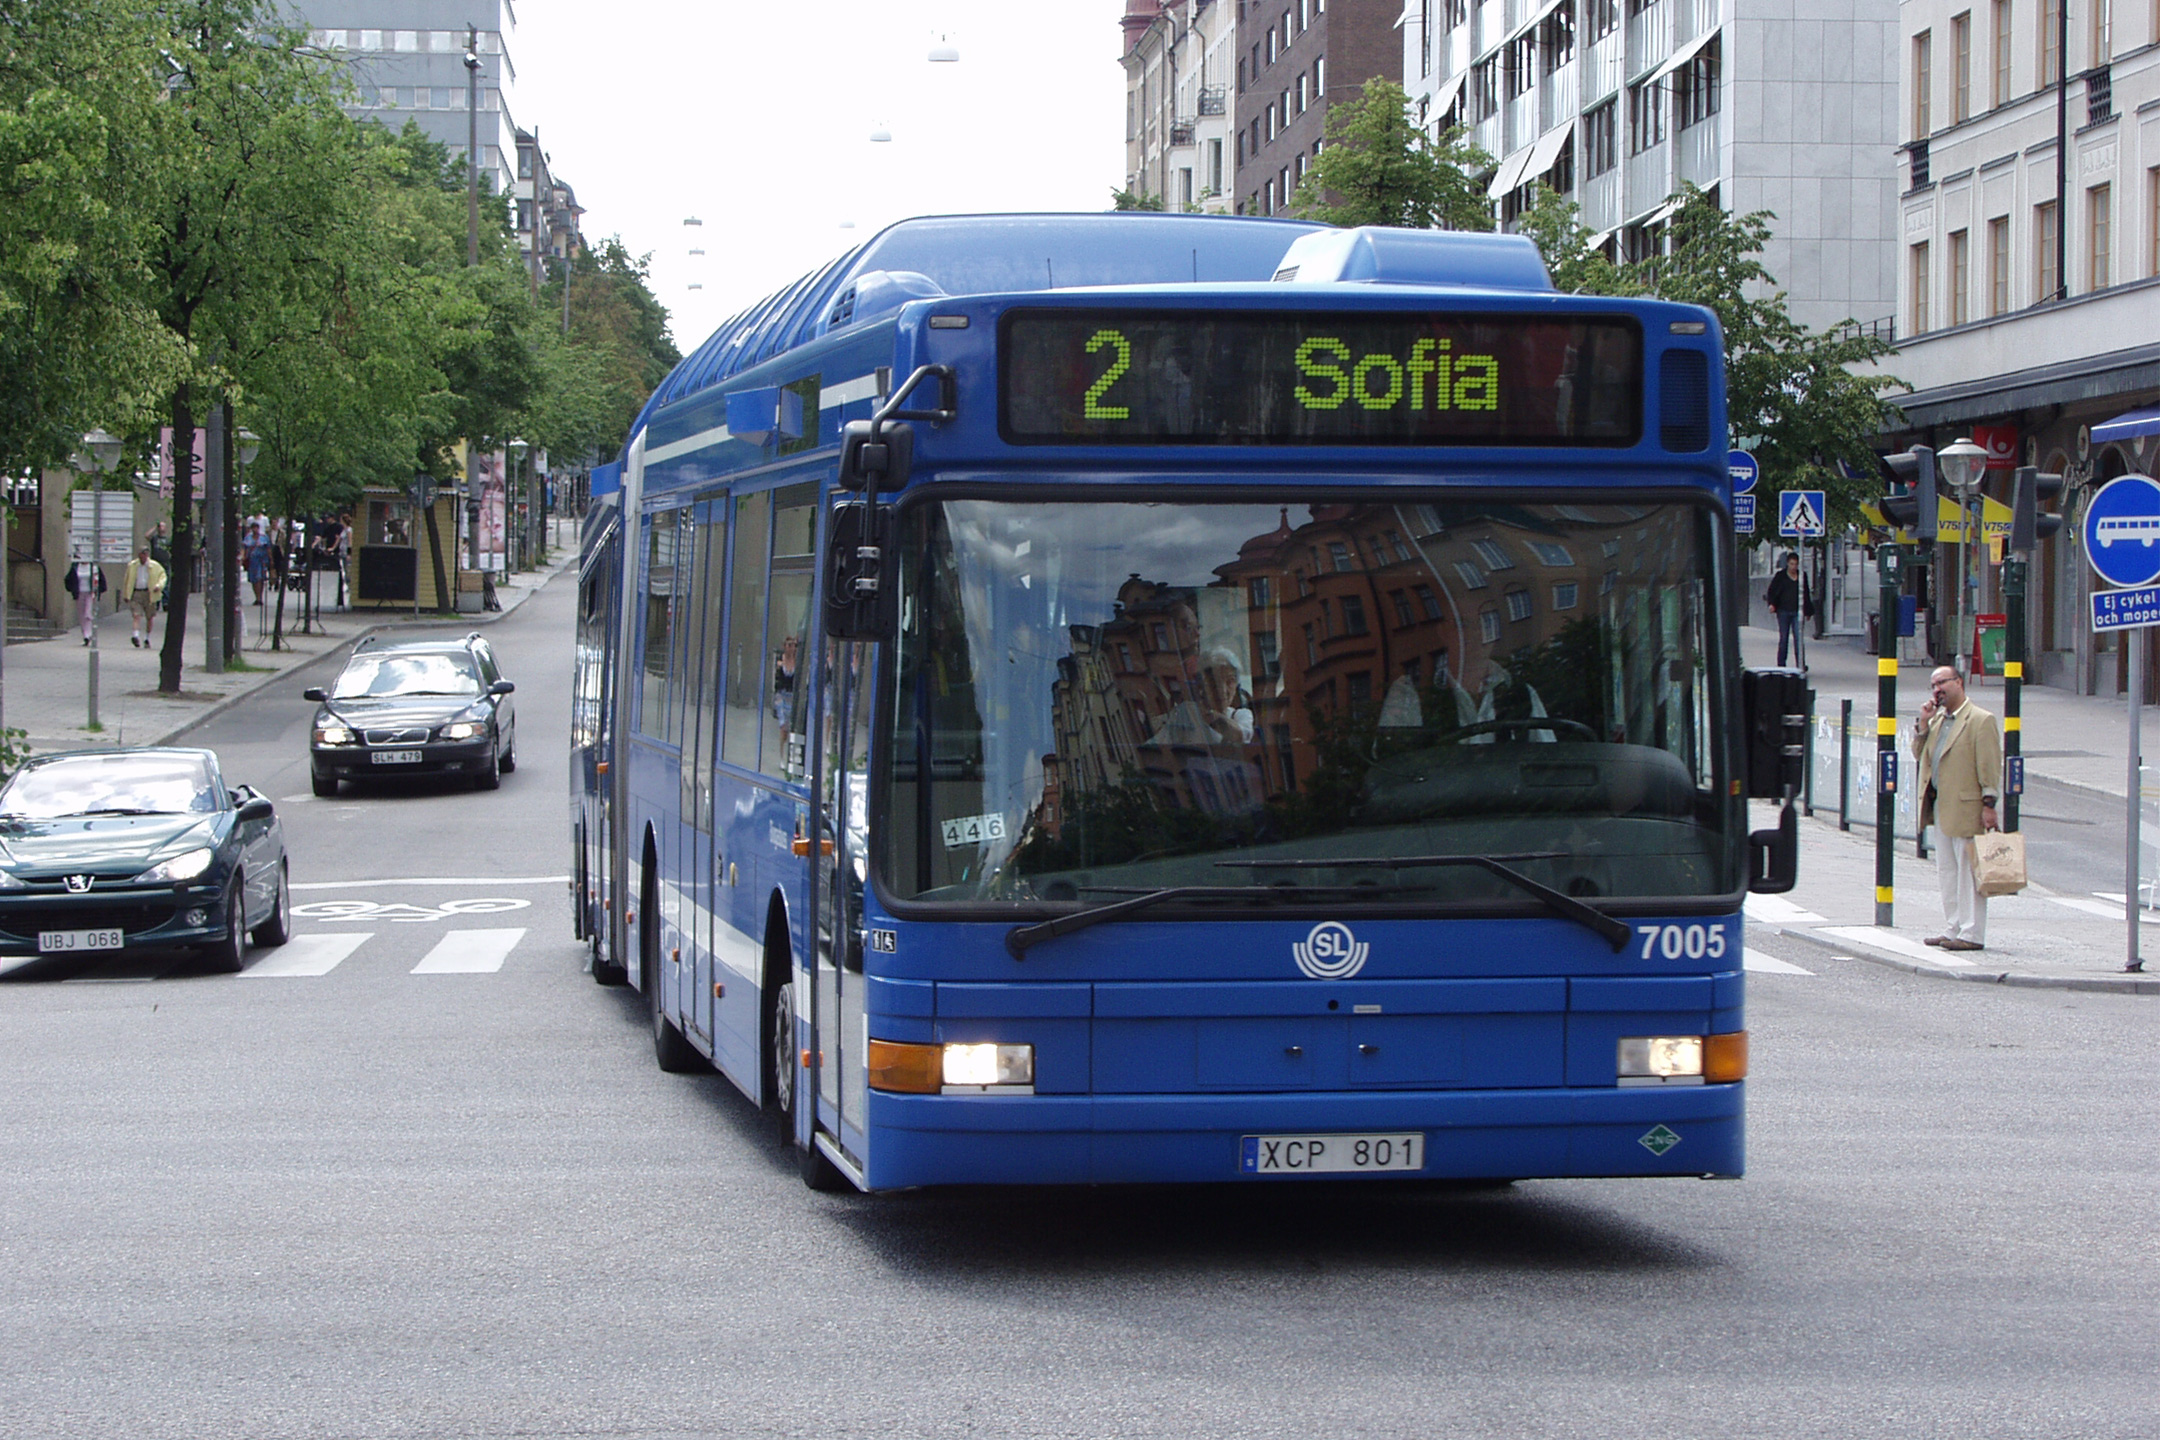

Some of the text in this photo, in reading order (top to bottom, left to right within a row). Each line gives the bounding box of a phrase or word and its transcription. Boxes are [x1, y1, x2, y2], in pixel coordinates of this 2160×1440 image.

[1085, 330, 1498, 419] 2 Sofia
[2104, 591, 2156, 610] Ej cykel
[2096, 609, 2160, 625] och mope
[374, 751, 421, 763] SLH 479
[947, 820, 1002, 842] 446
[43, 931, 119, 949] UBJ 068
[1315, 932, 1347, 957] SL
[1637, 924, 1726, 960] 7005
[1263, 1140, 1325, 1169] XCP
[1353, 1138, 1412, 1167] 801
